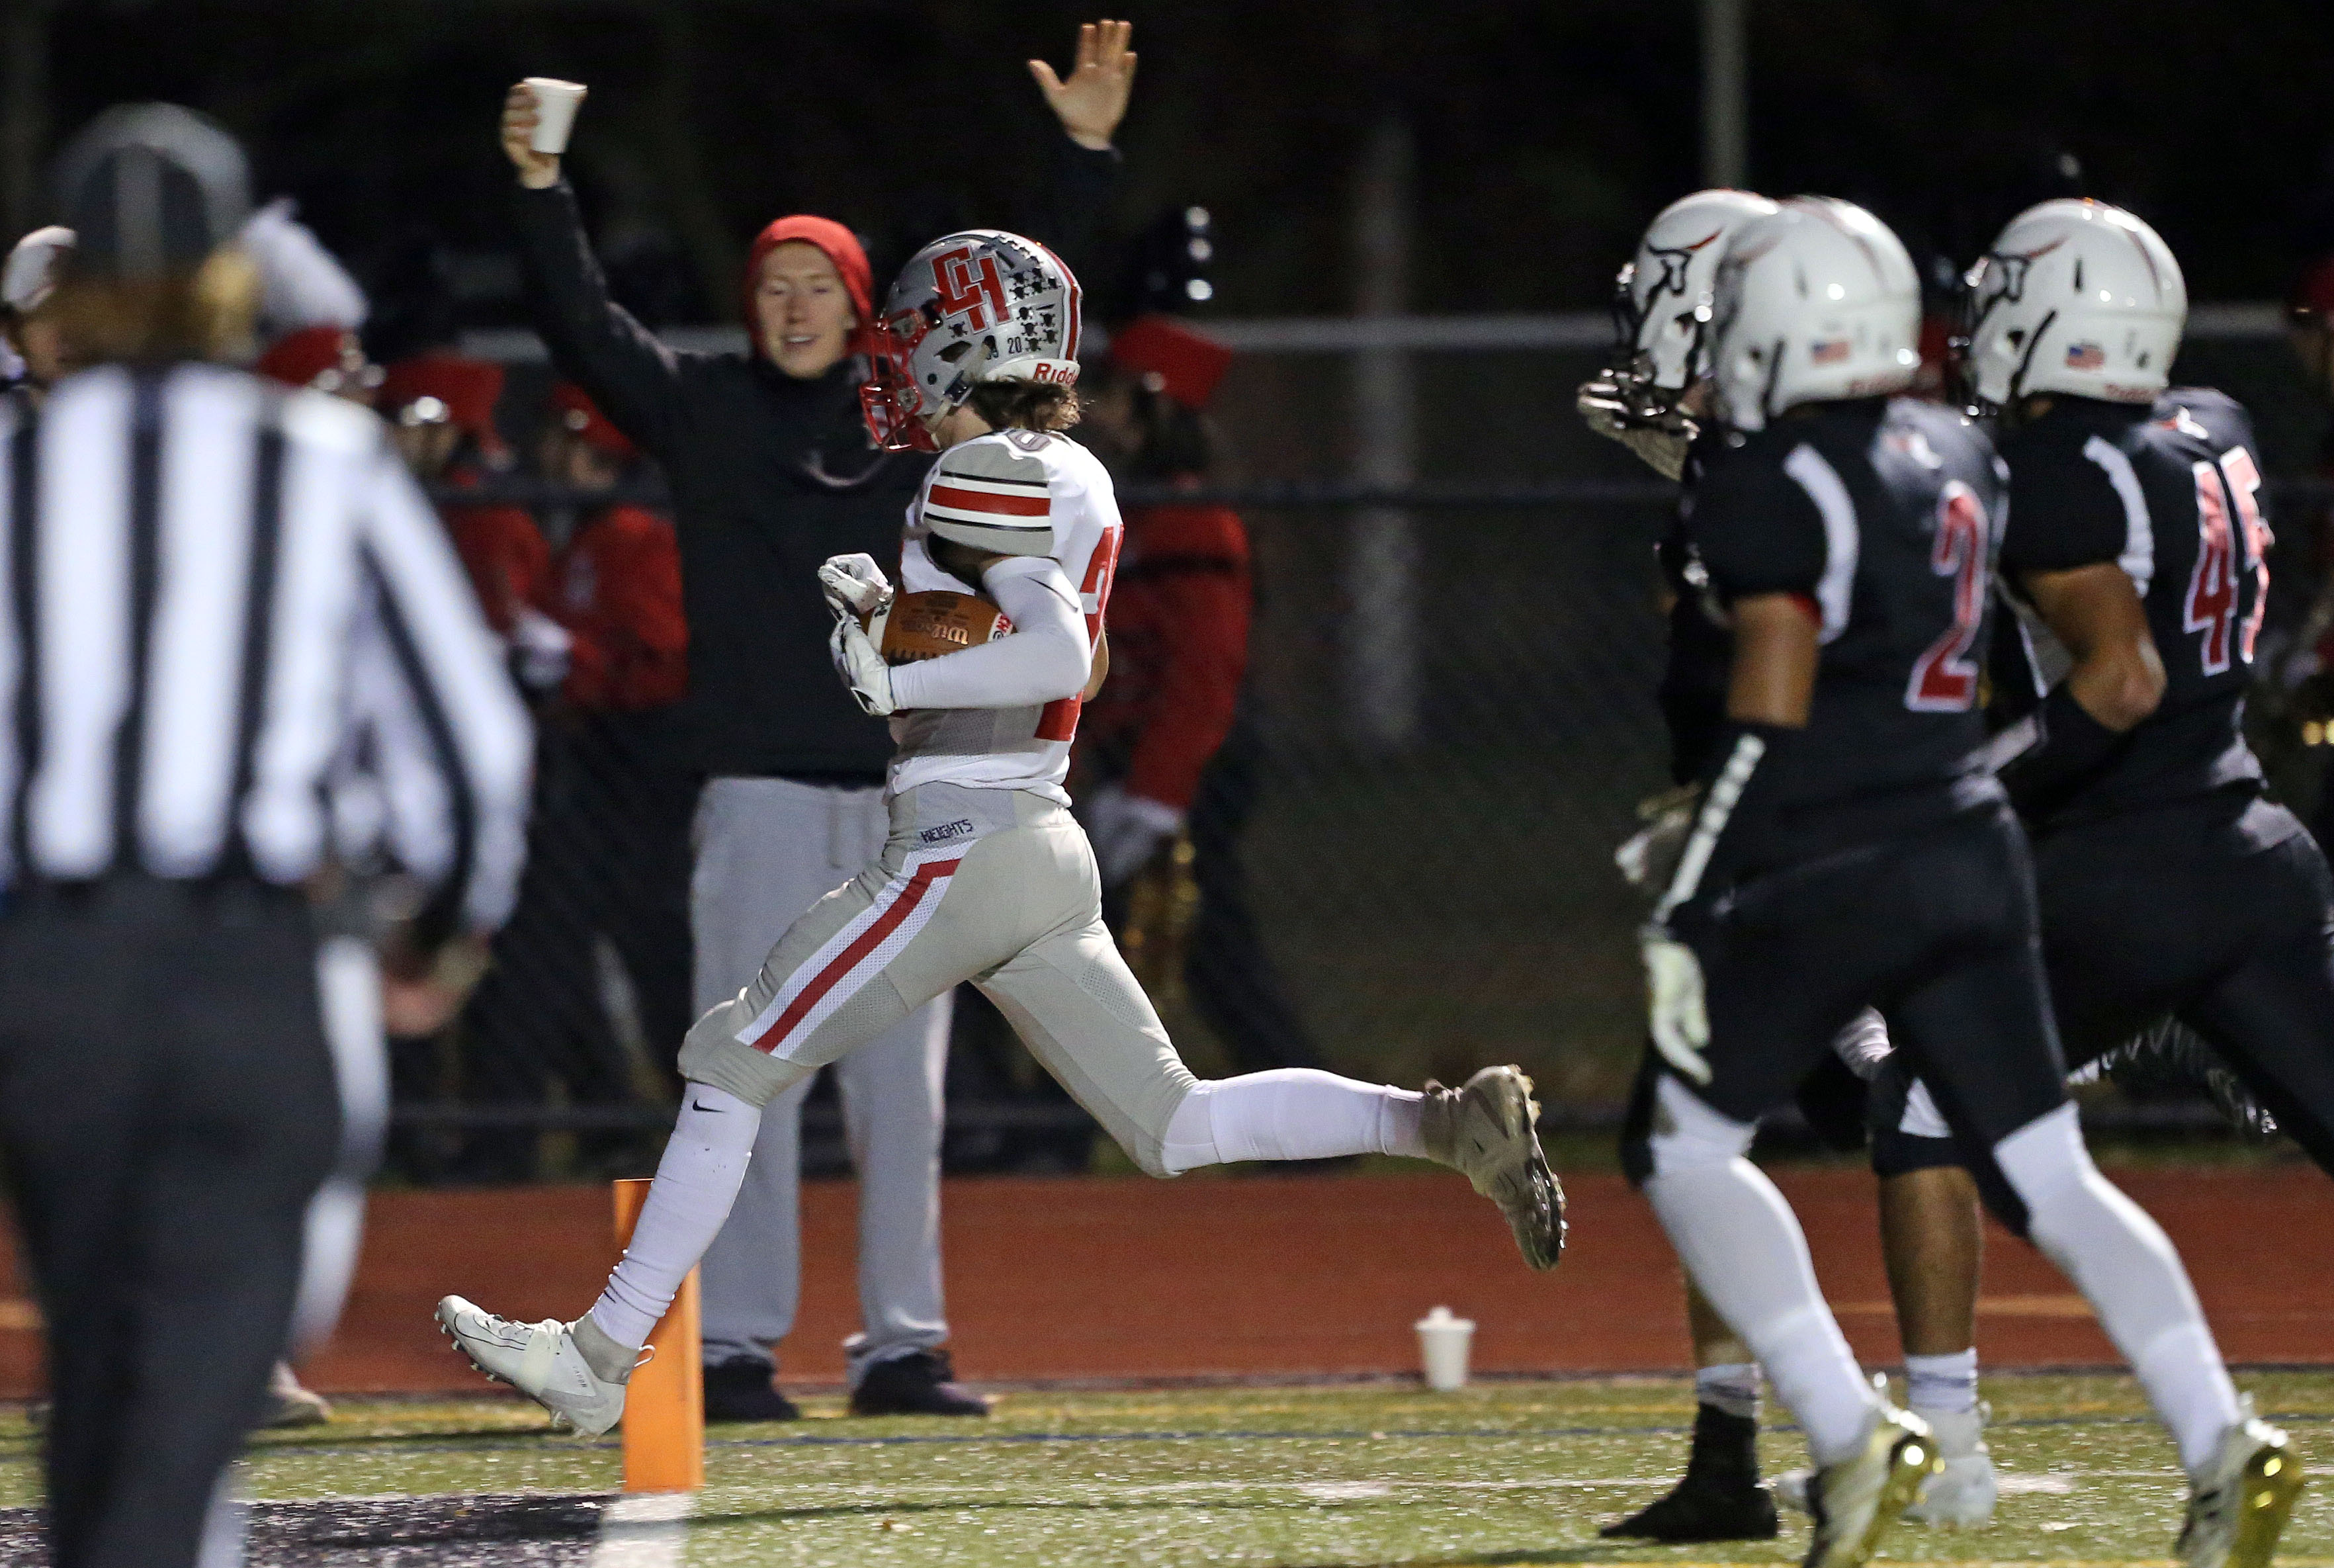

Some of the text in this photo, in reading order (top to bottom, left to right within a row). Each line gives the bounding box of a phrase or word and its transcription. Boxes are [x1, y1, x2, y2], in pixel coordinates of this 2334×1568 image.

[1007, 336, 1022, 354] 20
[1903, 479, 1988, 713] 2
[920, 818, 973, 844] HEIGHTS
